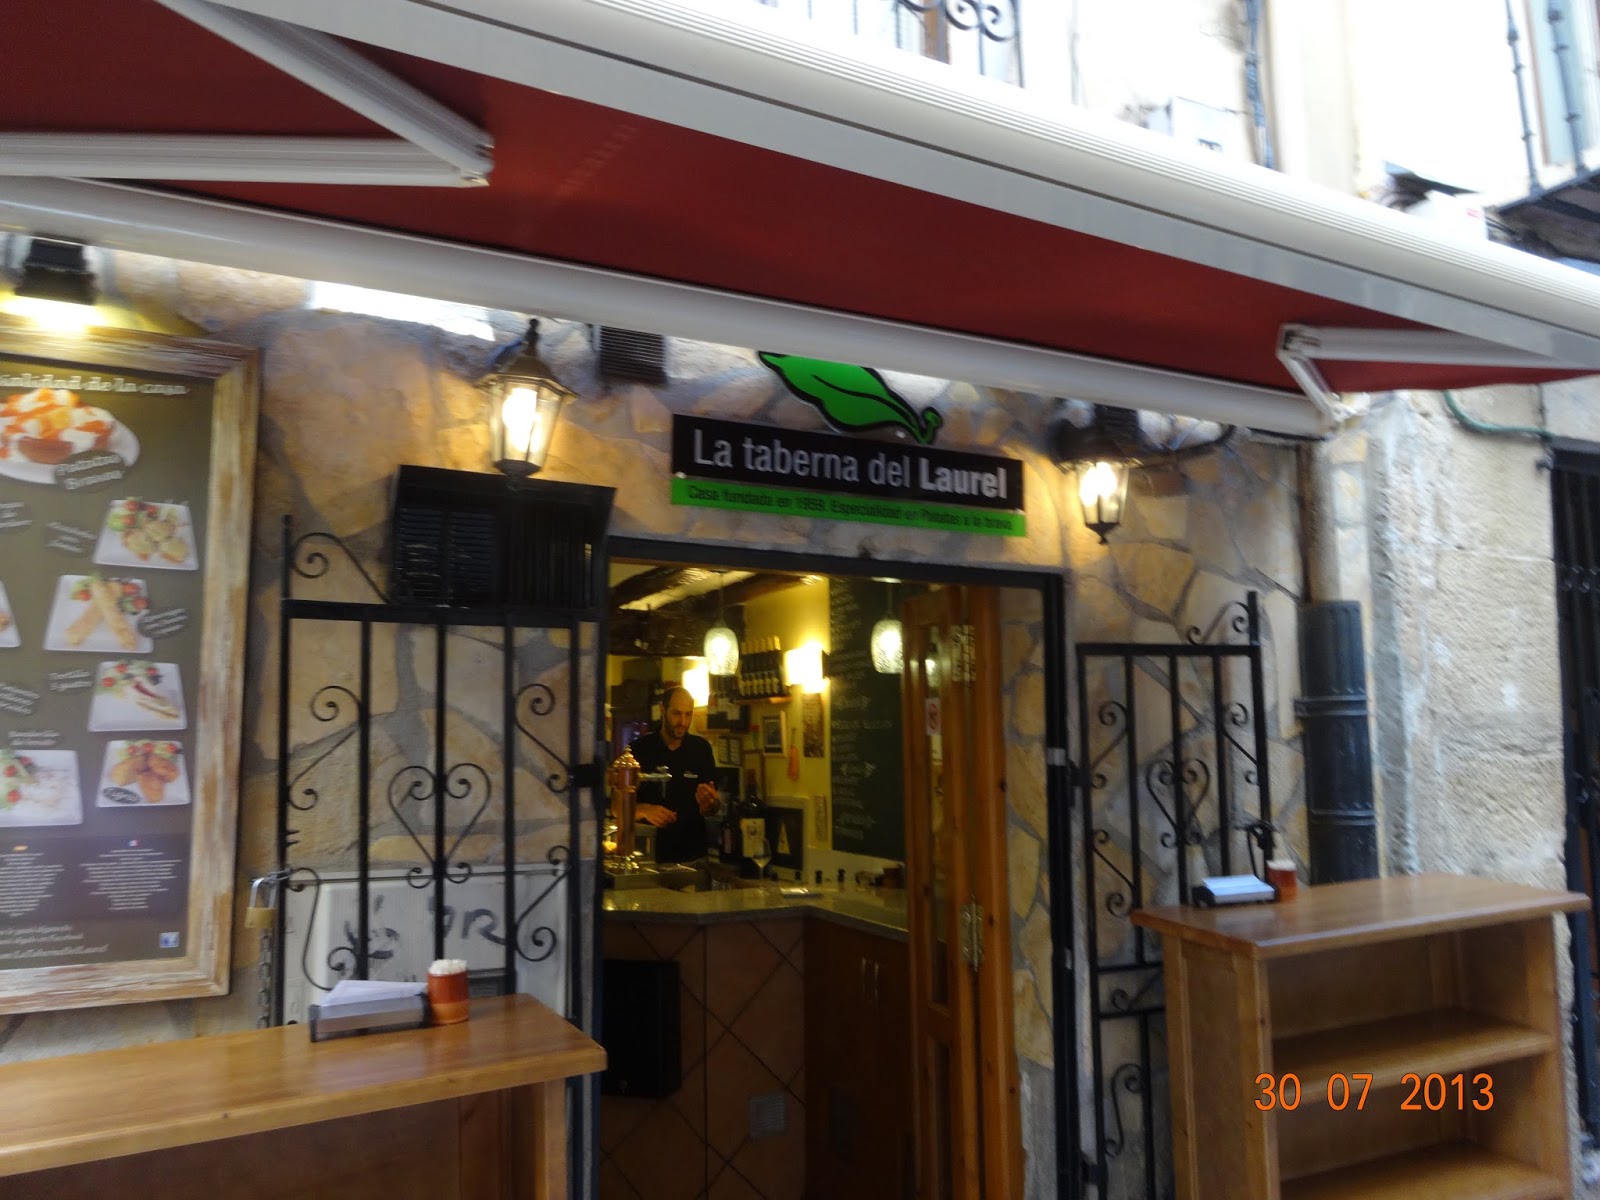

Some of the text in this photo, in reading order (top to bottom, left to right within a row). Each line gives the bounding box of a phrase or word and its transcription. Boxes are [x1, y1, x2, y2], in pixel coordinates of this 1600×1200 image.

[694, 429, 1007, 499] La taberna del Laurel
